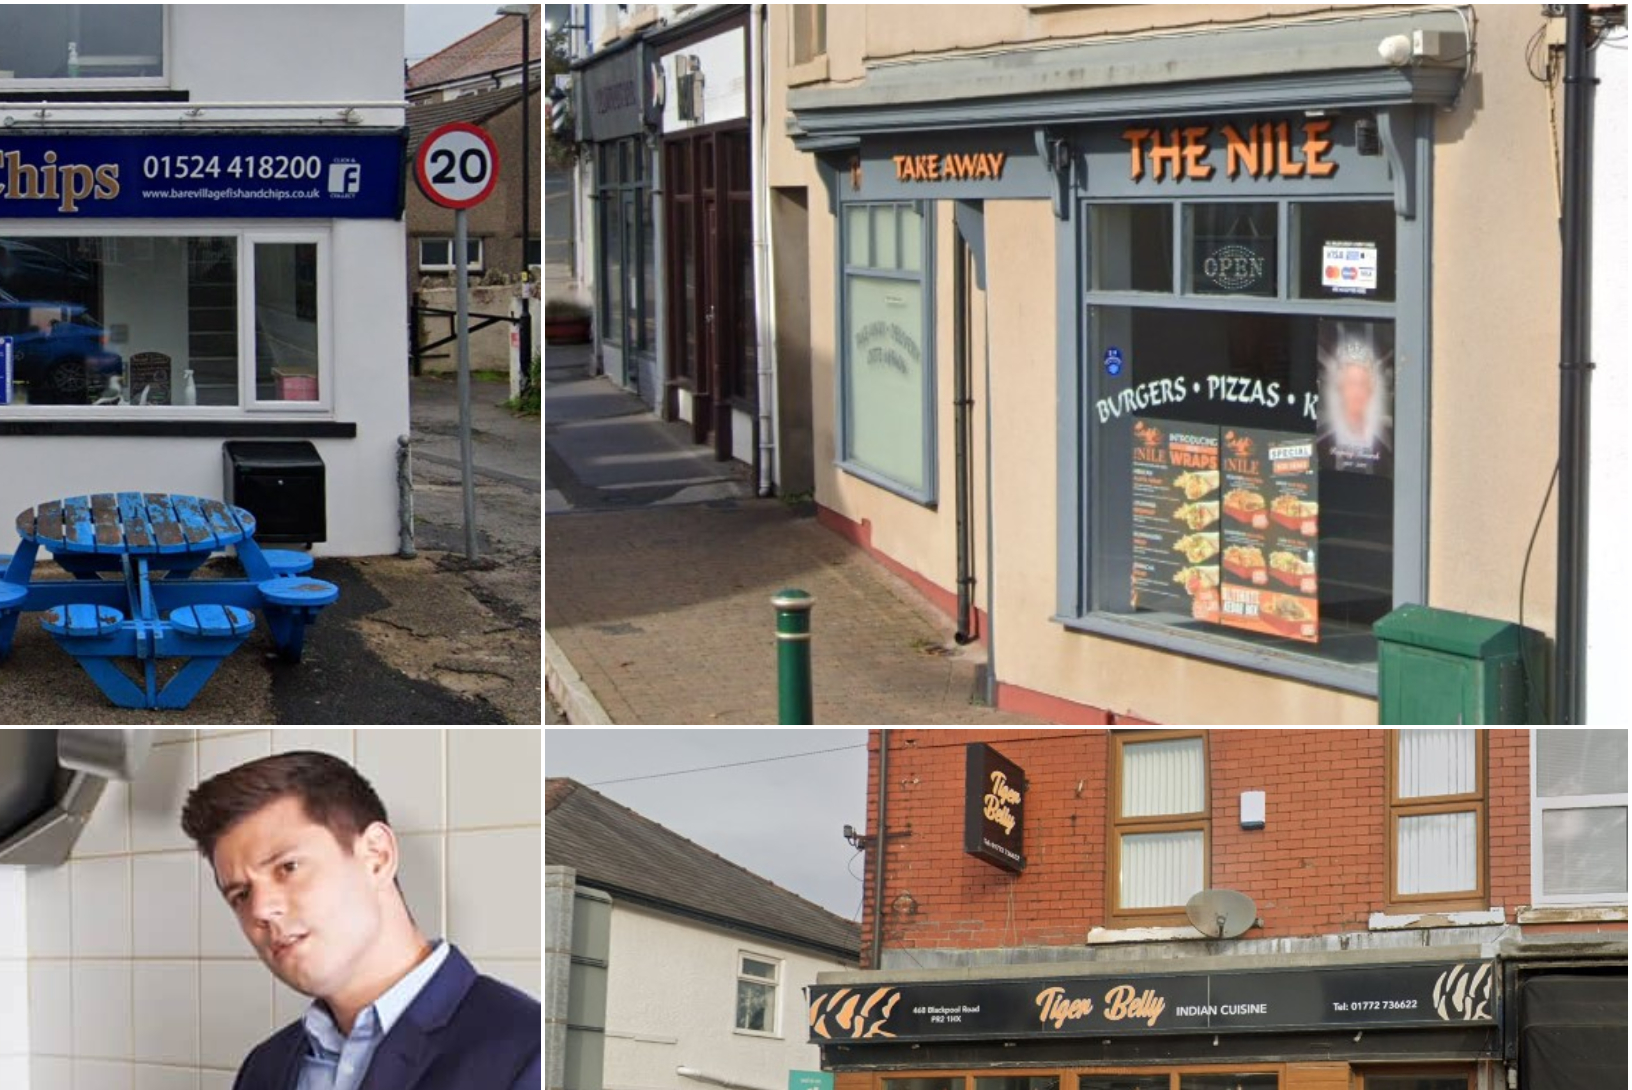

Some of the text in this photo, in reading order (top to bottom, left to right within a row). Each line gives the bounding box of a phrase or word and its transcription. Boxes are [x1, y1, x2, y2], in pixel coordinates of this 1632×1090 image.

[1123, 120, 1340, 183] THE NILE
[143, 156, 321, 178] 01524 418200
[430, 148, 488, 184] 20
[893, 153, 1005, 181] TAKE AWAY
[142, 188, 320, 200] www.barevillagefishandchips.co.uk
[1204, 257, 1264, 279] OPEN
[1096, 376, 1187, 423] BURGERS
[1207, 374, 1280, 408] PIZZAS
[1170, 451, 1218, 469] WRAPS
[990, 770, 1022, 806] Tiger
[983, 793, 1016, 836] Belly
[927, 1005, 961, 1015] Blackpool
[962, 1005, 980, 1013] Road
[1035, 984, 1166, 1029] Tiger Belly
[1176, 1003, 1267, 1017] INDIAN CUISINE
[1333, 999, 1418, 1011] Tel: 01772 736622
